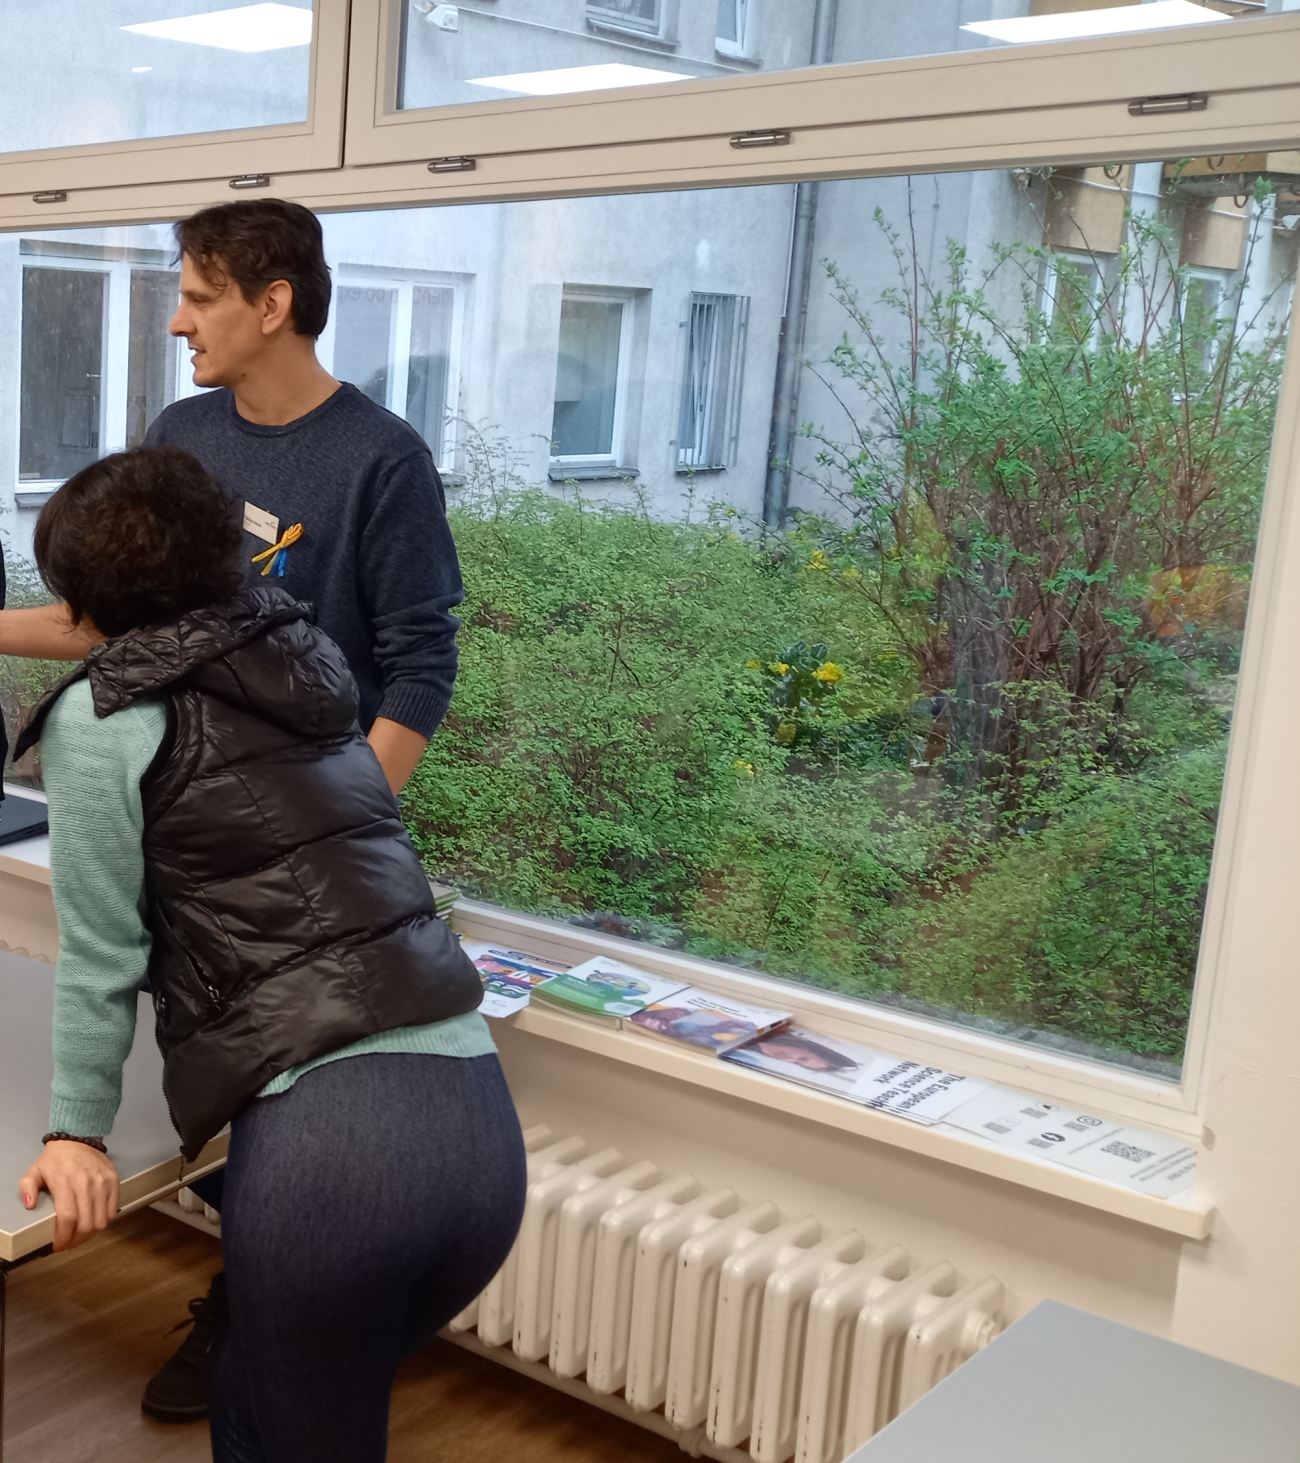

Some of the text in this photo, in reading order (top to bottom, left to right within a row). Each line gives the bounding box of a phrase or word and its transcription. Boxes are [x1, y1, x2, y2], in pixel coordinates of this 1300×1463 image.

[872, 1060, 921, 1084] Network
[898, 1066, 943, 1089] Science
[896, 1073, 967, 1109] The European
